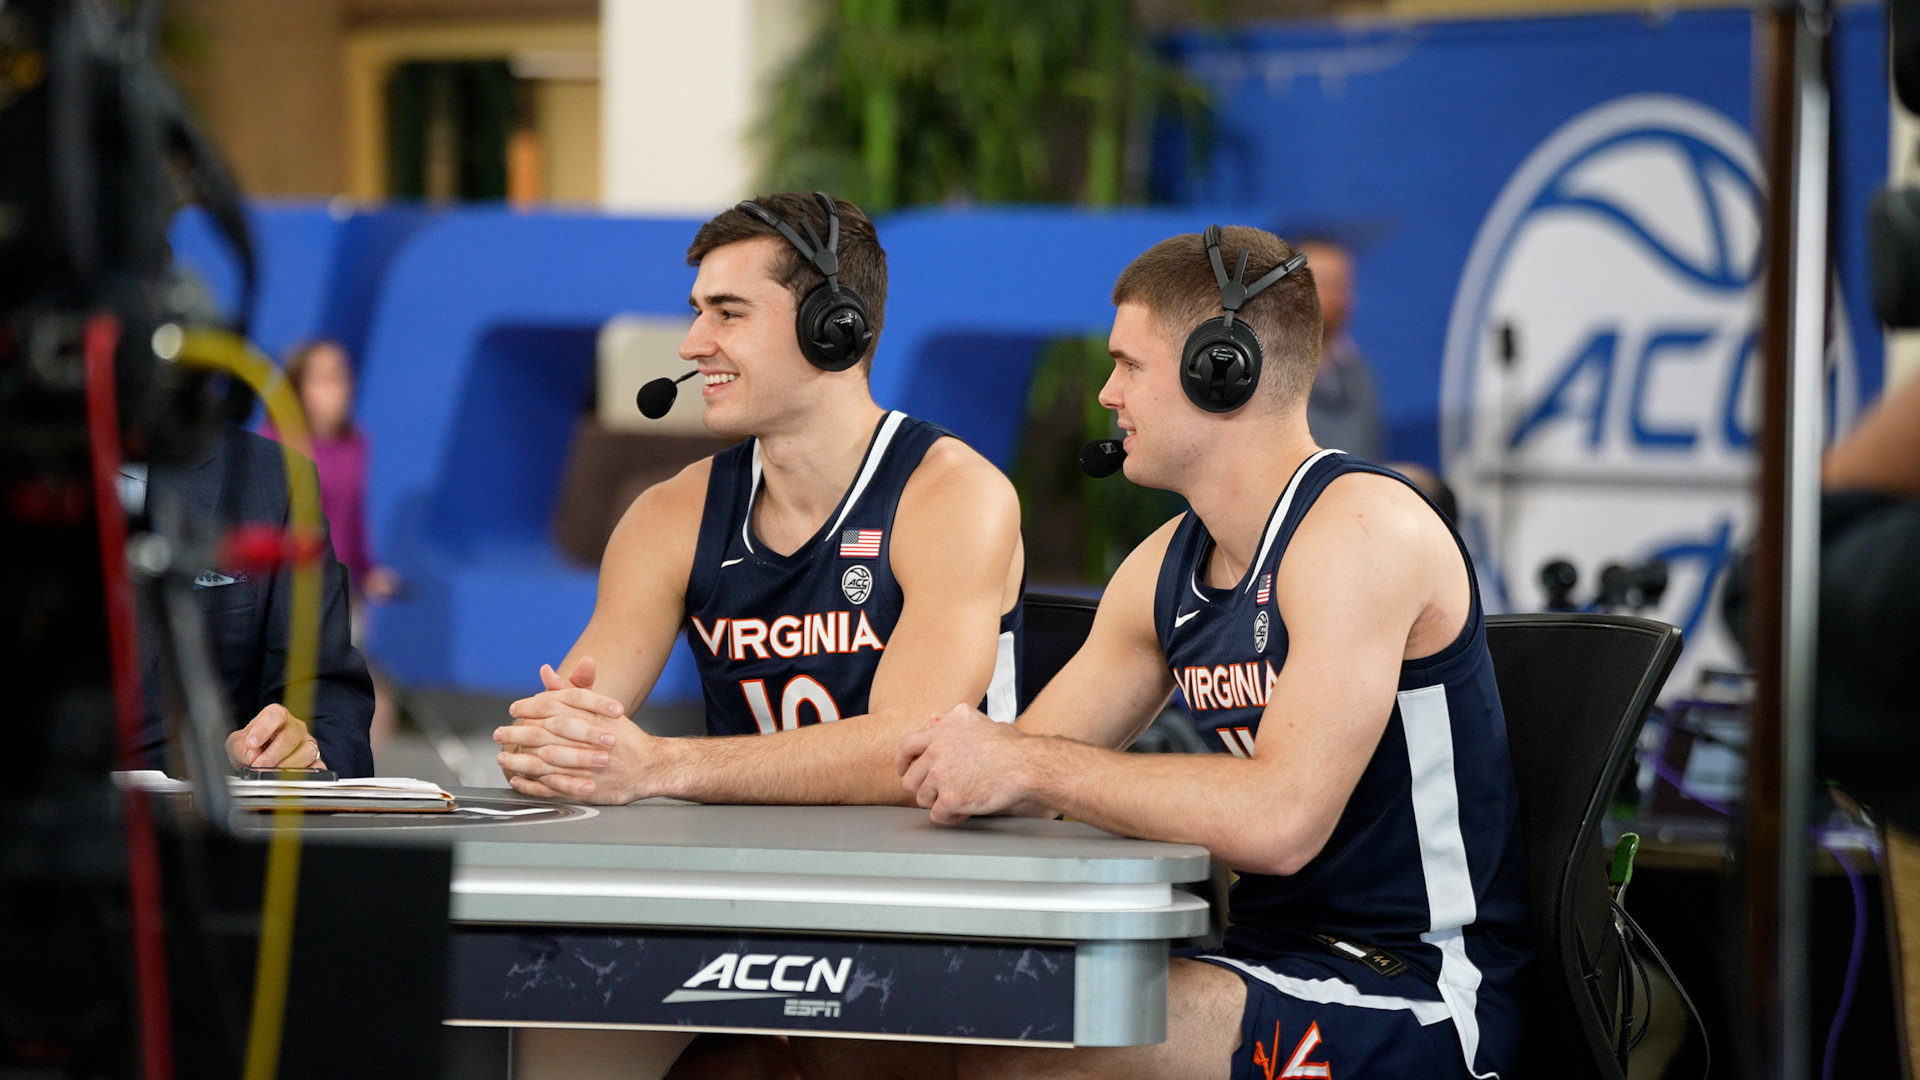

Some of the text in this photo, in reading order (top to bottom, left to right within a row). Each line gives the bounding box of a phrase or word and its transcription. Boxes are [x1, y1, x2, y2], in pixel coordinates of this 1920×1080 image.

[847, 578, 871, 589] ACC
[691, 608, 885, 660] VIRGINIA
[1173, 660, 1279, 711] VIRGINIA
[682, 952, 853, 993] ACCN
[783, 998, 842, 1018] ESPN
